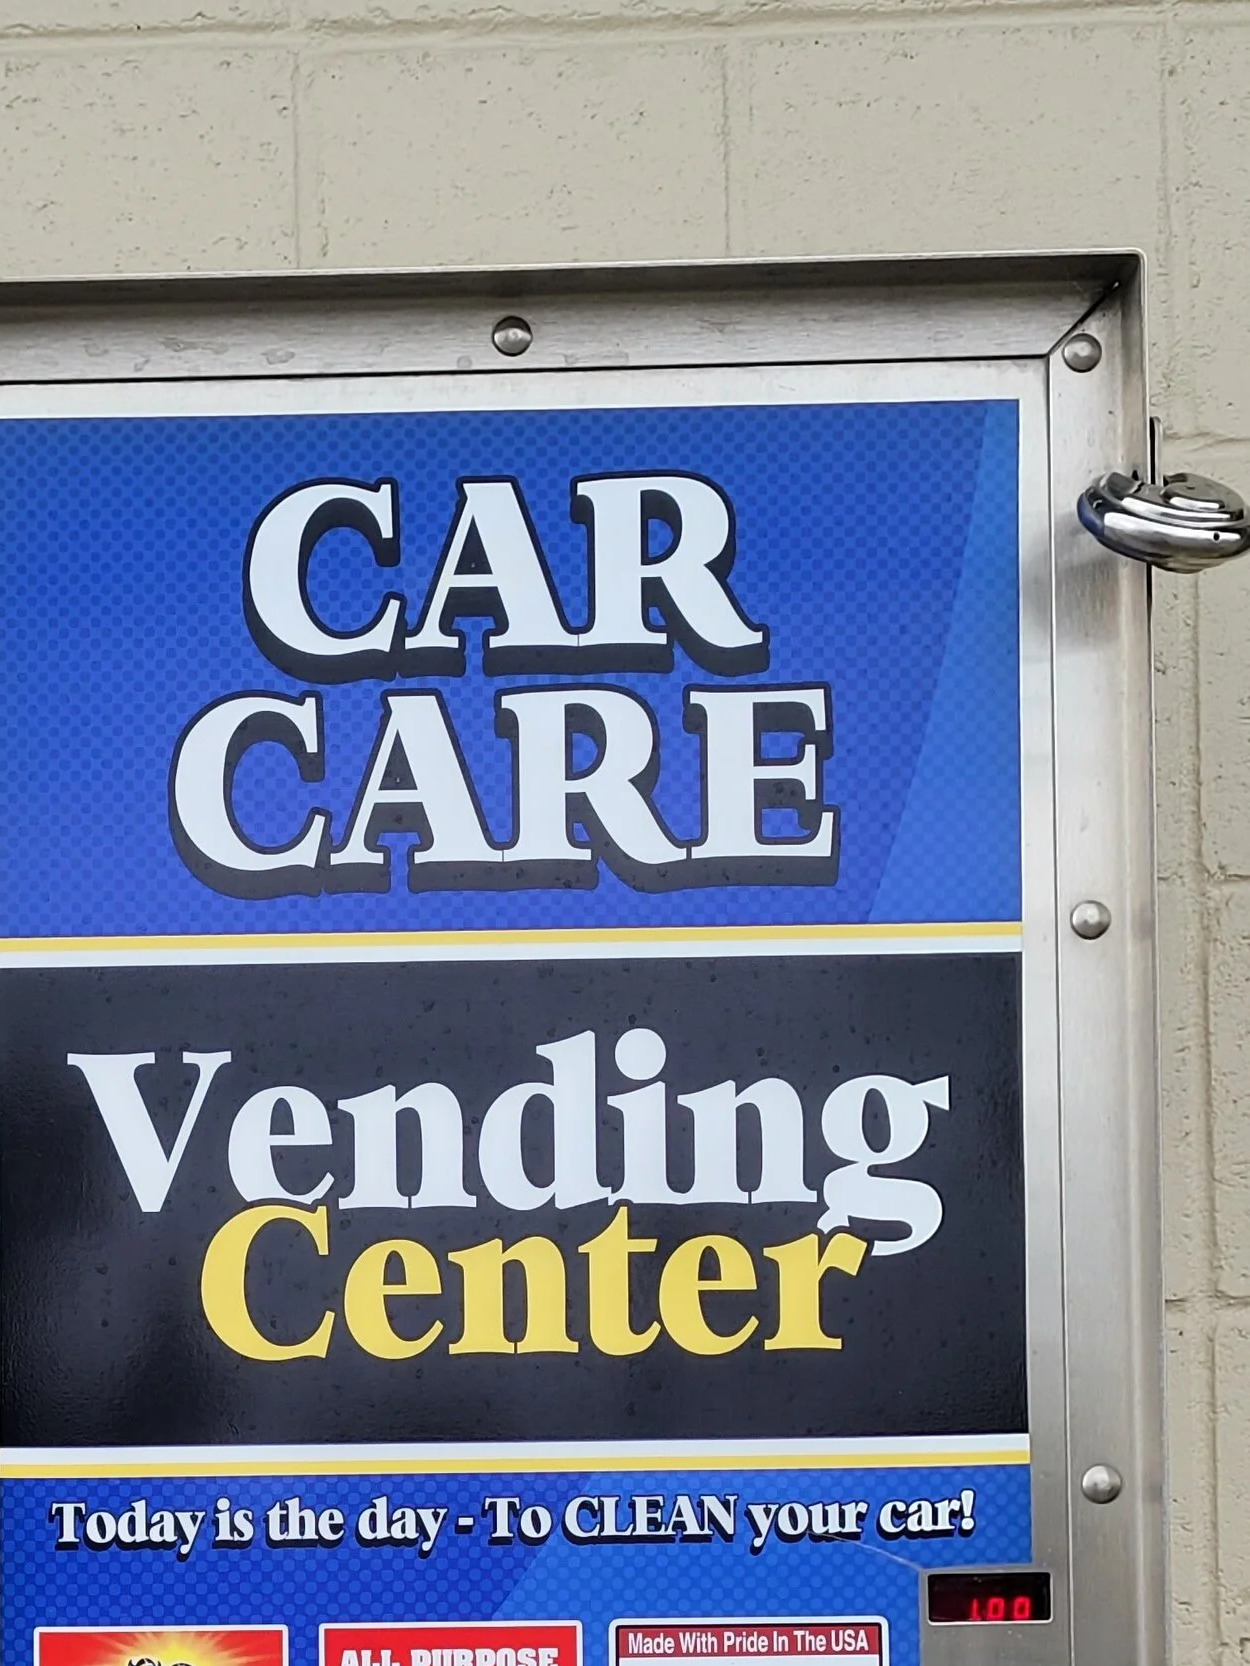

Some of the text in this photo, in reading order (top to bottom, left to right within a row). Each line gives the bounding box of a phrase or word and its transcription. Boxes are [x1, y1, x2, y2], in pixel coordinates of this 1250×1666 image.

[242, 470, 769, 682] CAR
[167, 684, 840, 898] CARE
[67, 1027, 949, 1256] Vending
[200, 1205, 869, 1361] Center
[51, 1498, 206, 1559] Today
[213, 1497, 254, 1545] is
[265, 1497, 345, 1546] the
[357, 1496, 448, 1556] day
[483, 1496, 552, 1543] To
[564, 1493, 740, 1543] CLEAN
[749, 1500, 869, 1553] your
[877, 1489, 977, 1539] car!
[627, 1629, 870, 1655] Made With Pride In The USA
